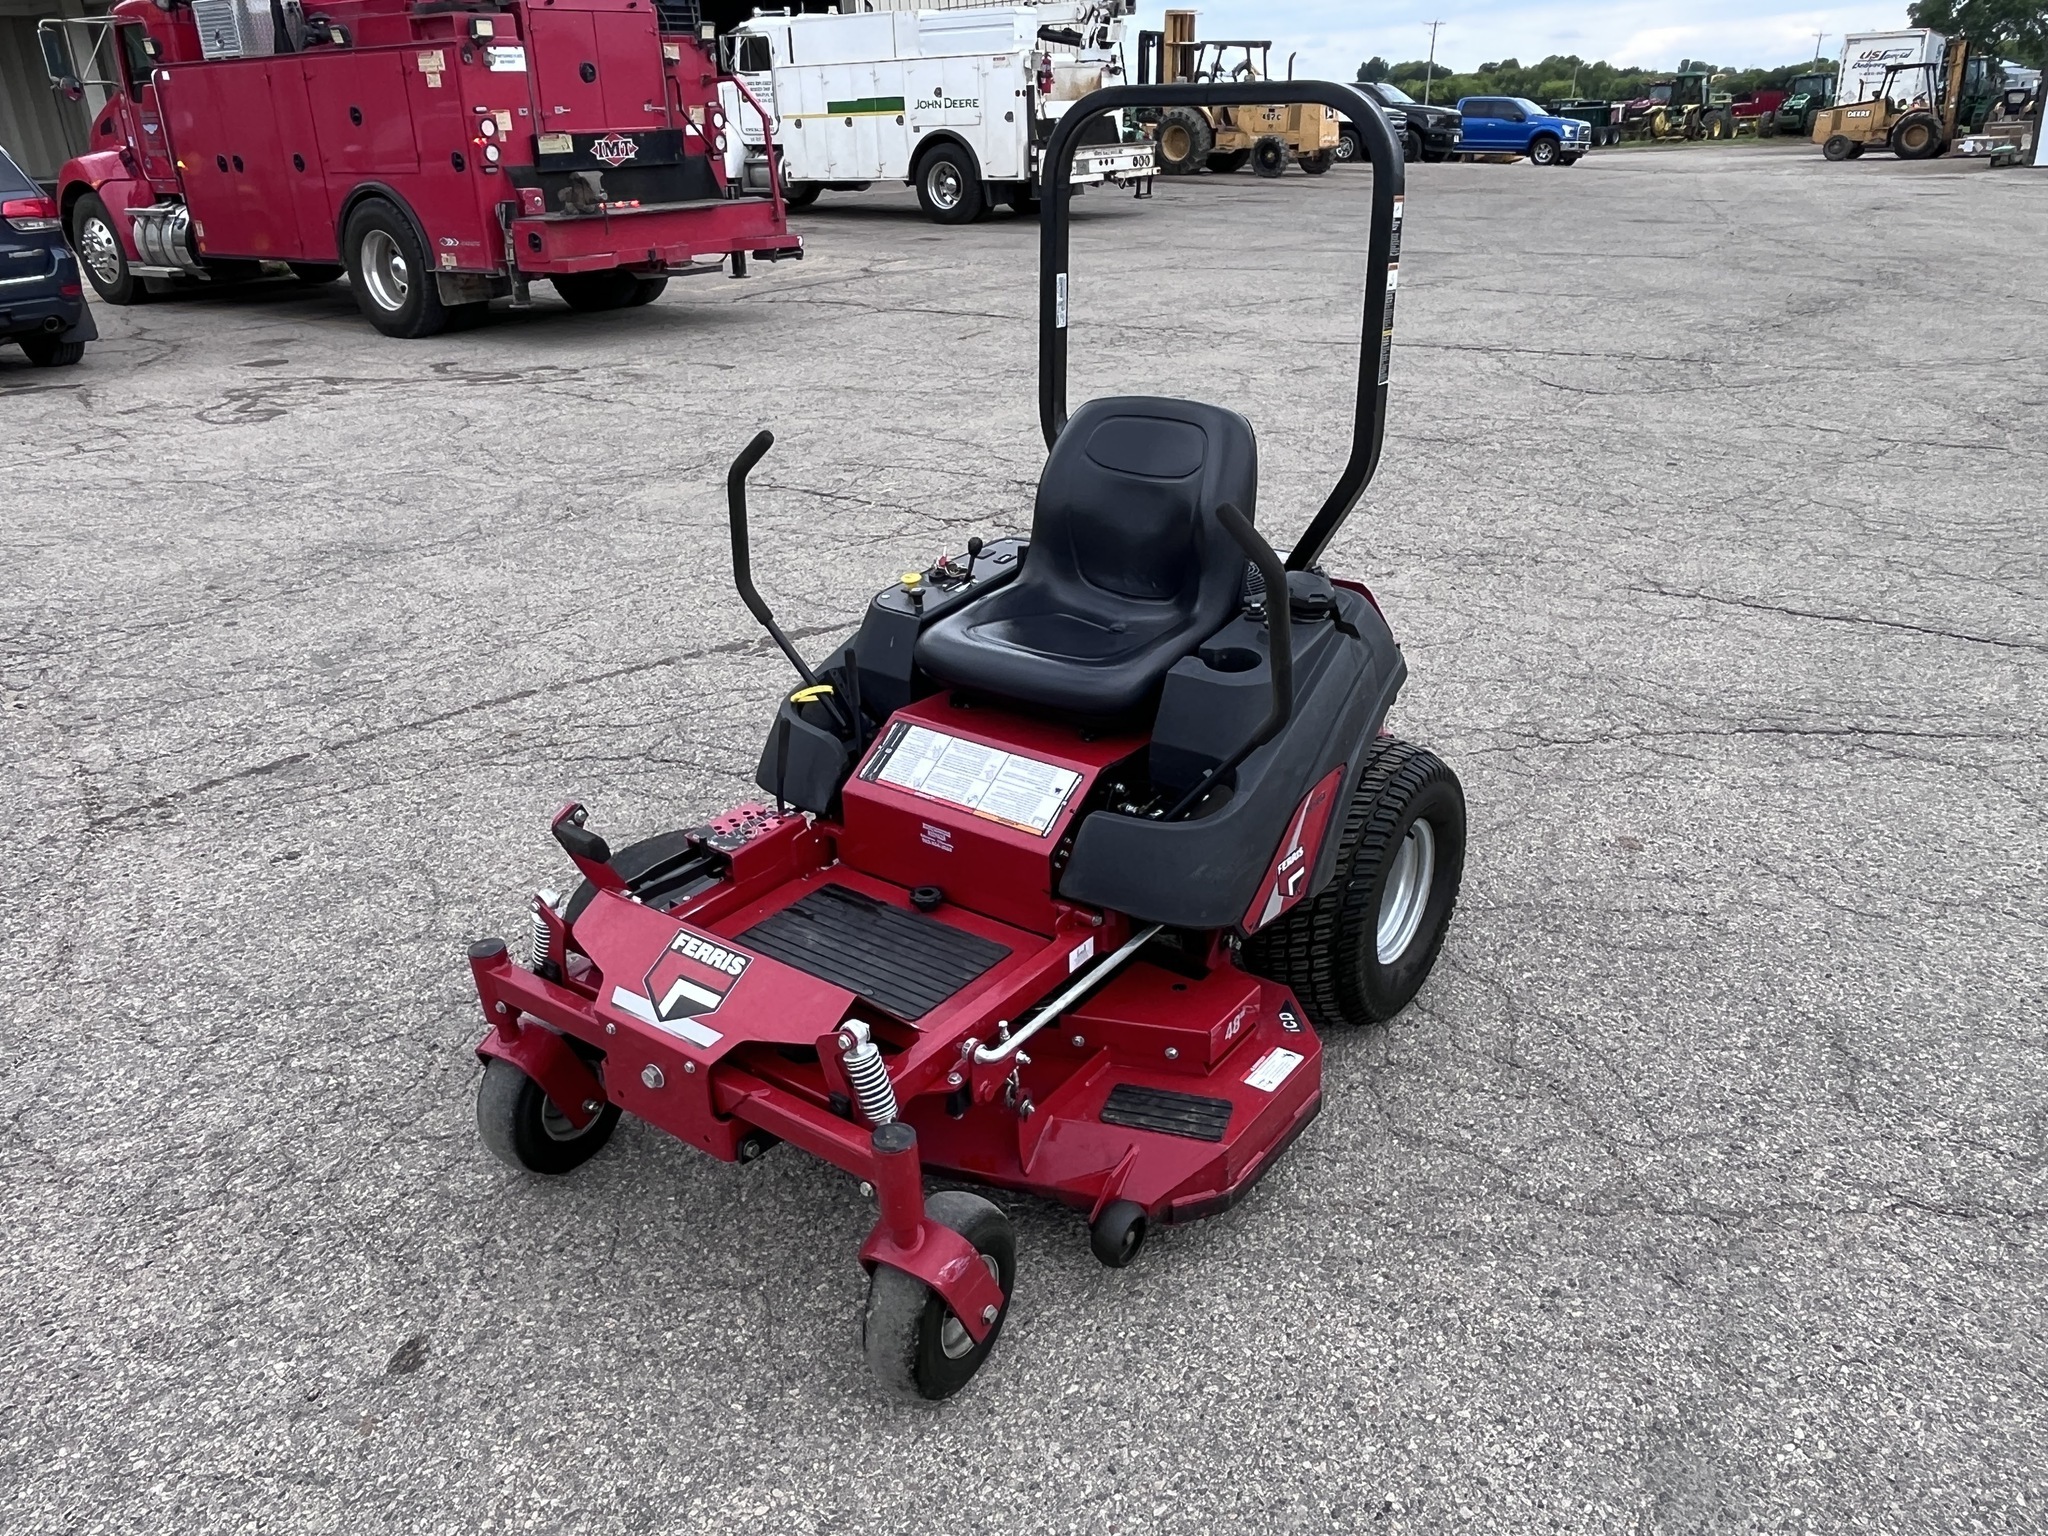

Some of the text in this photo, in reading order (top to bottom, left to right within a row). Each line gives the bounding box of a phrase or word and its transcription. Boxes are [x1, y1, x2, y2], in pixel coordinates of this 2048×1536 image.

[914, 97, 980, 110] JOHN DEERE
[1847, 110, 1870, 118] DEERE
[595, 138, 635, 160] IMT
[1277, 846, 1304, 876] FERRIS
[671, 932, 746, 976] FERRIS
